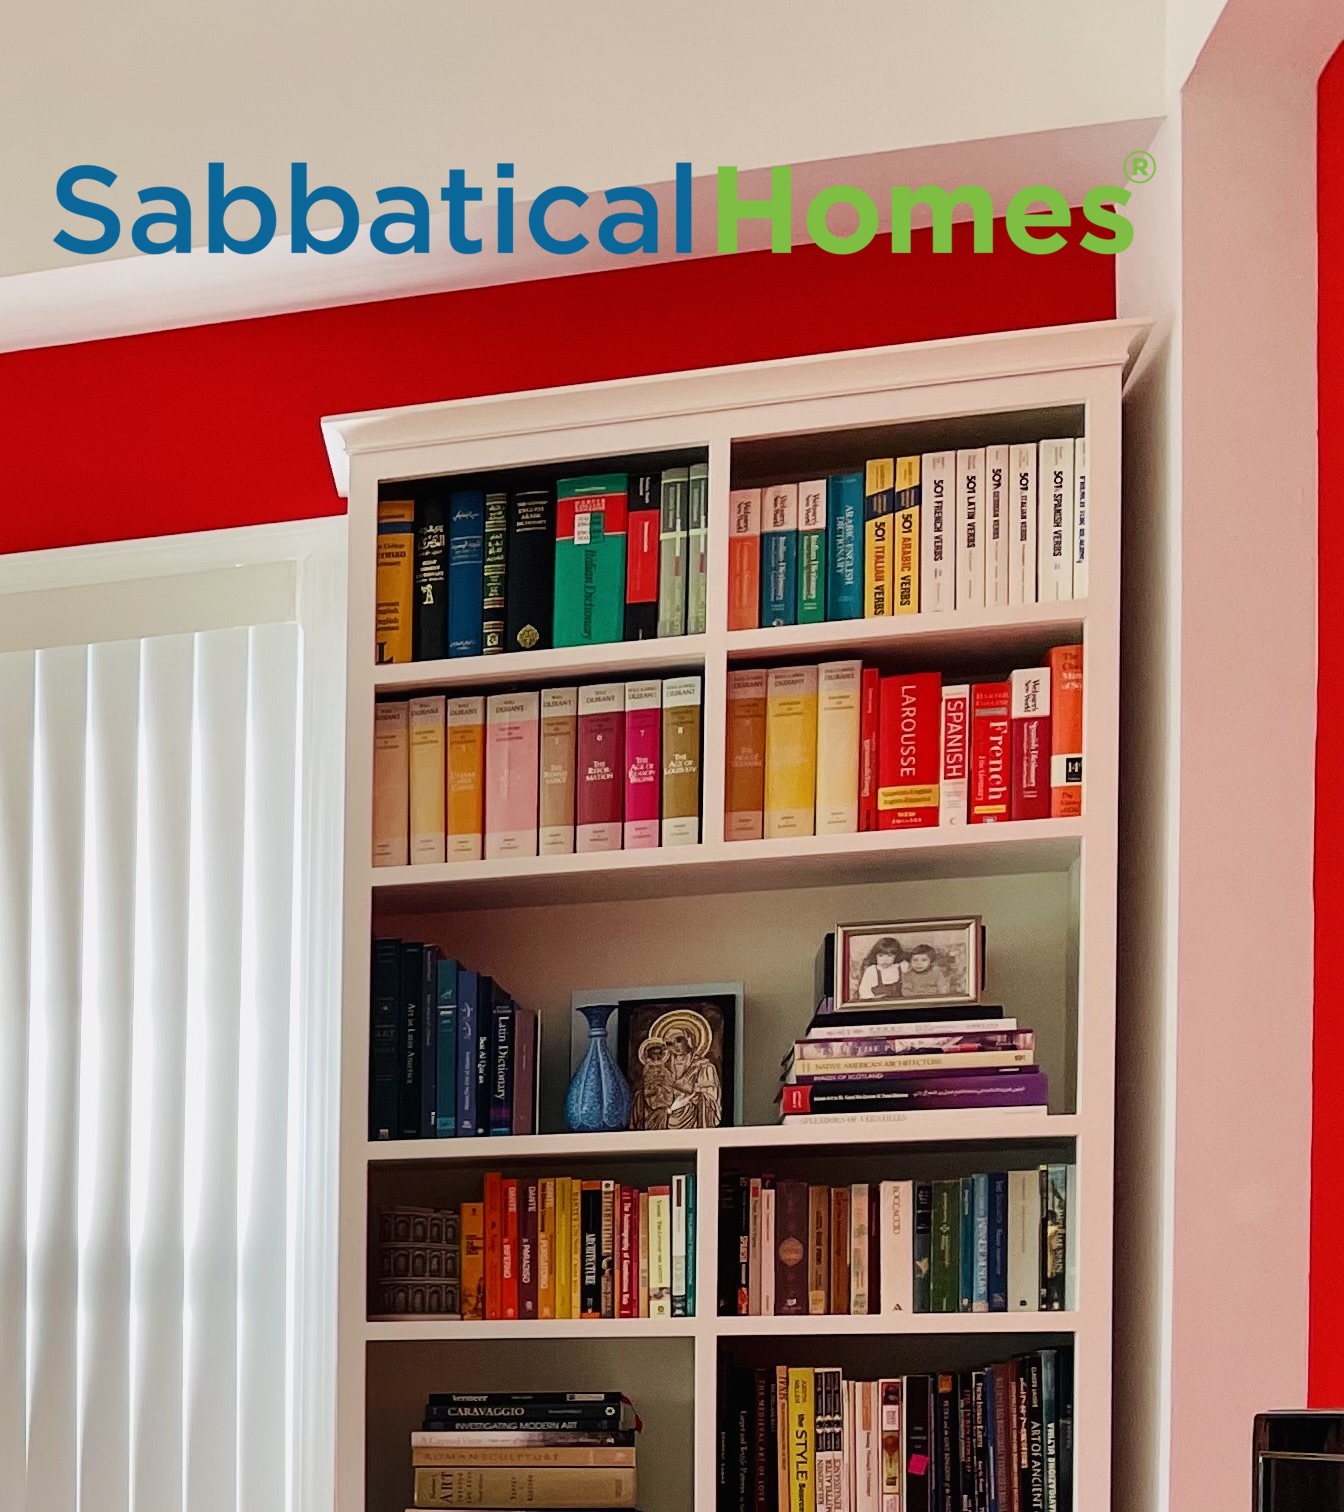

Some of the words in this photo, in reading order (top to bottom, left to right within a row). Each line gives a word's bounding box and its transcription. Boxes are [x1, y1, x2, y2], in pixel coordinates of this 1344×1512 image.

[933, 479, 944, 498] 501
[967, 475, 976, 494] 501
[1020, 472, 1029, 491] 501
[1053, 470, 1064, 489] 501
[967, 496, 976, 520] LATIN
[1053, 493, 1064, 527] SPANISH
[874, 521, 886, 542] 501
[900, 513, 912, 534] 501
[967, 522, 976, 548] VERBS
[900, 537, 912, 572] ARABIC
[1053, 530, 1064, 557] VERBS
[874, 545, 886, 582] ITALIAN
[874, 585, 886, 616] VERBS
[900, 575, 912, 606] VERBS
[900, 685, 917, 778] LAROUSSE
[946, 700, 963, 778] SPANISH
[988, 720, 1008, 800] French
[498, 1016, 510, 1042] Latin
[494, 1045, 509, 1100] Dictionary
[447, 1407, 525, 1416] CARAVAGGIO
[798, 1414, 806, 1427] the
[519, 1421, 559, 1430] MODERN
[1031, 1421, 1042, 1442] ART
[796, 1429, 808, 1480] STYLE
[1031, 1444, 1042, 1458] OF
[1031, 1460, 1042, 1507] ANCIENT
